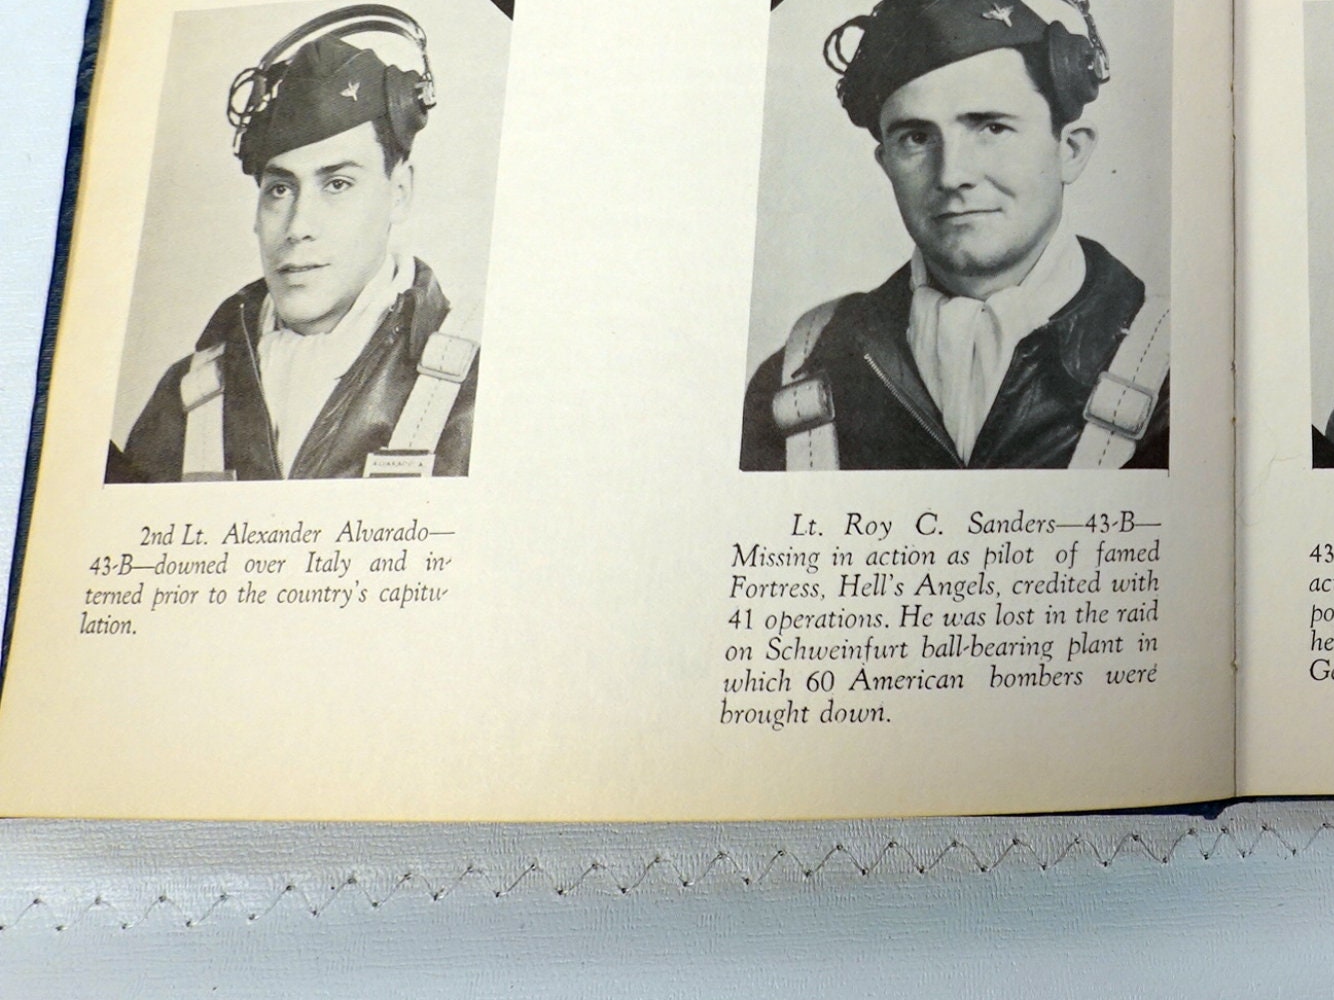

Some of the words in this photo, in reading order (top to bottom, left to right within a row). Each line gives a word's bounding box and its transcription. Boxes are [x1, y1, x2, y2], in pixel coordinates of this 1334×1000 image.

[139, 522, 176, 547] 2nd
[180, 522, 208, 546] Lt.
[220, 520, 323, 545] Alexander
[790, 512, 824, 537] Lt.
[843, 511, 893, 542] Roy
[914, 511, 944, 536] C.
[243, 558, 287, 574] over
[304, 549, 352, 579] Italy
[368, 548, 408, 573] and
[730, 541, 821, 575] Missing
[831, 551, 854, 567] in
[865, 544, 936, 567] action
[946, 549, 971, 566] as
[983, 540, 1035, 571] pilot
[1054, 539, 1080, 570] of
[1095, 538, 1161, 568] famed
[728, 574, 826, 602] Fortress,
[837, 571, 905, 598] Hell's
[912, 570, 1001, 604] Angels,
[1011, 569, 1102, 596] credited
[1111, 568, 1160, 593] with
[724, 645, 753, 662] on
[765, 635, 909, 666] Schweinfurt
[921, 632, 1055, 663] ball-bearing
[1066, 630, 1124, 663] plant
[1137, 631, 1158, 653] in
[722, 667, 792, 694] which
[805, 669, 836, 693] 60
[847, 667, 965, 692] American
[989, 662, 1084, 689] bombers
[1105, 663, 1158, 685] were
[719, 696, 811, 732] brought
[819, 697, 891, 724] down.
